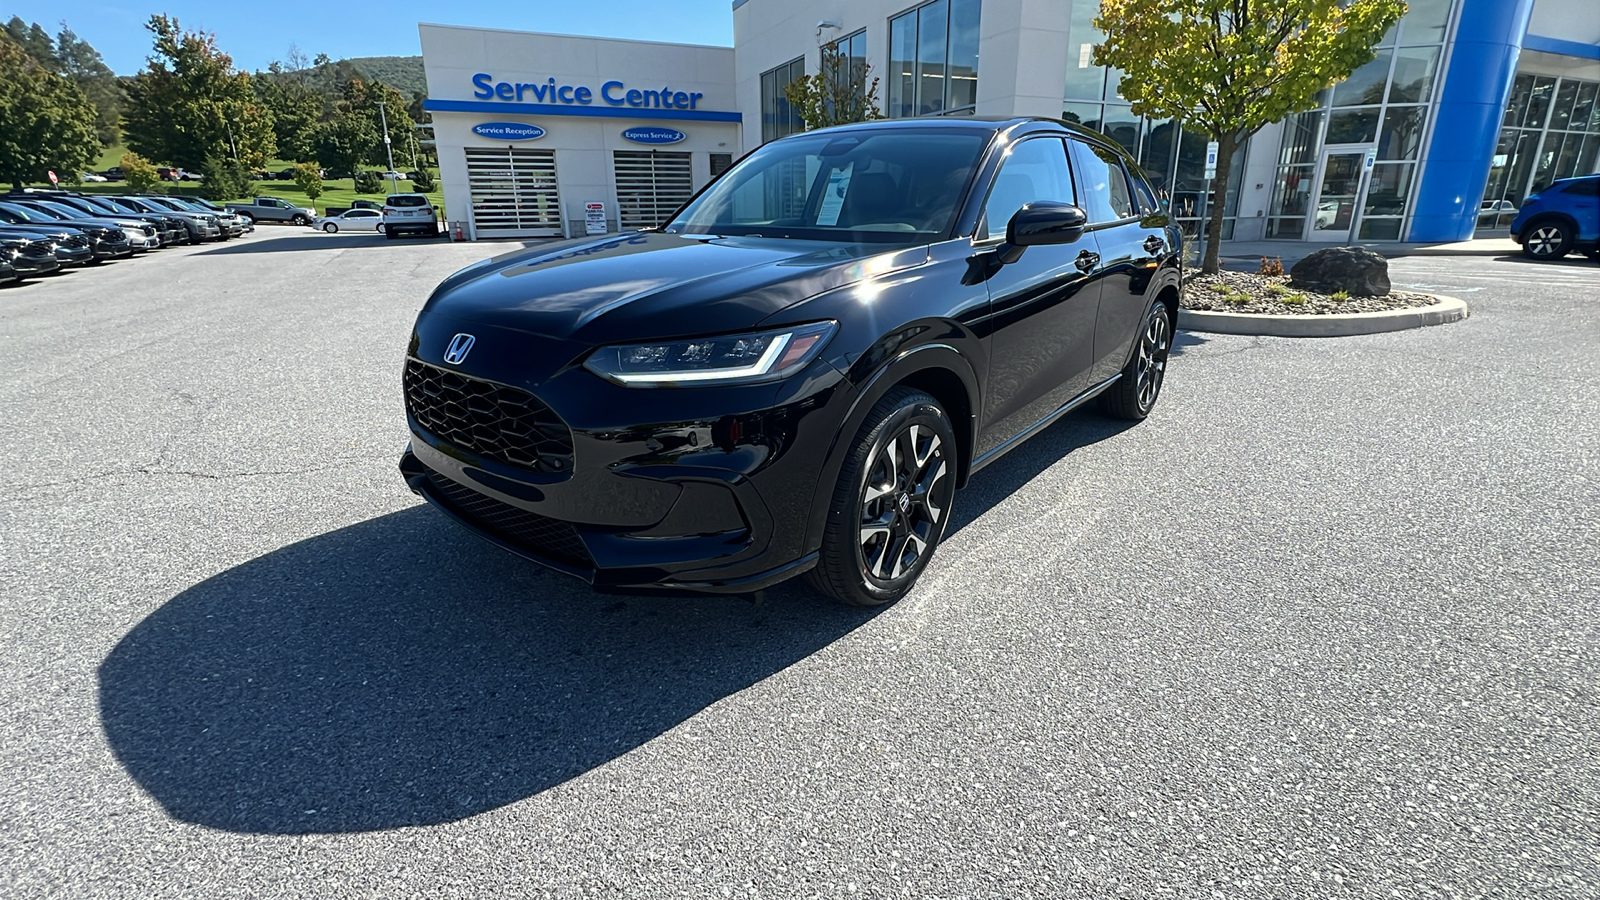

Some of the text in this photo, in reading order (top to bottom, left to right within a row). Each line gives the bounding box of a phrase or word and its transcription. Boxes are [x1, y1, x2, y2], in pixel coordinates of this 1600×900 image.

[472, 73, 703, 109] Service Center
[476, 126, 541, 136] Service Reception
[625, 131, 649, 139] Express
